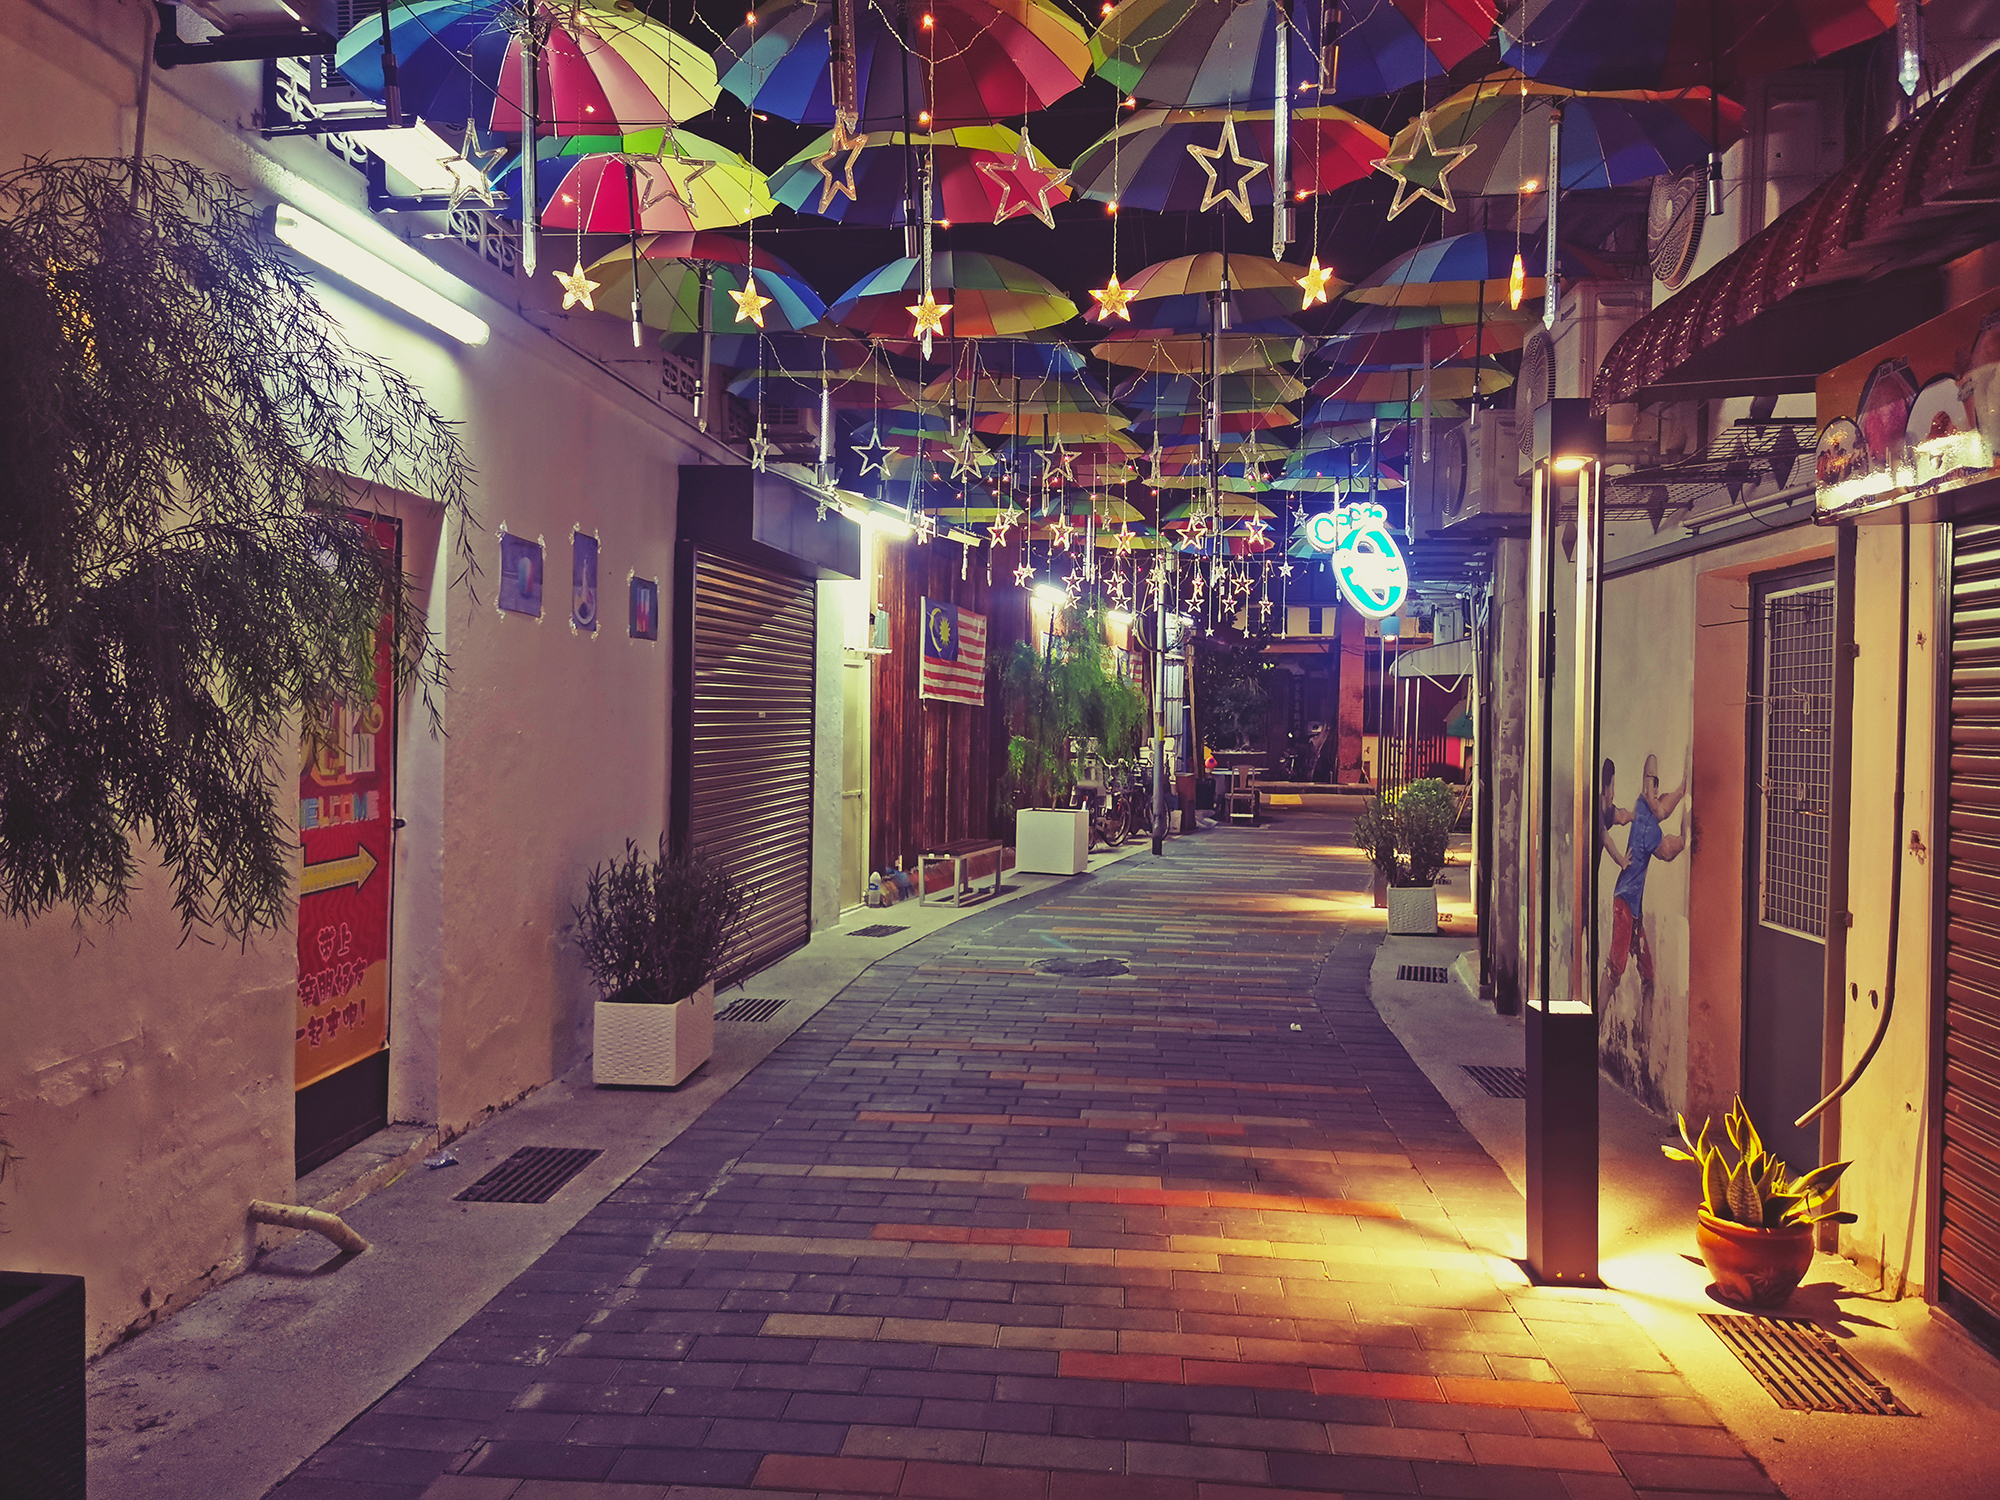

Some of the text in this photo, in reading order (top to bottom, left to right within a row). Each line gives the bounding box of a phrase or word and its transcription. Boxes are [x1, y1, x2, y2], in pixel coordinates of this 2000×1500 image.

[317, 922, 352, 962] 带上
[298, 957, 367, 1008] 亲朋好友
